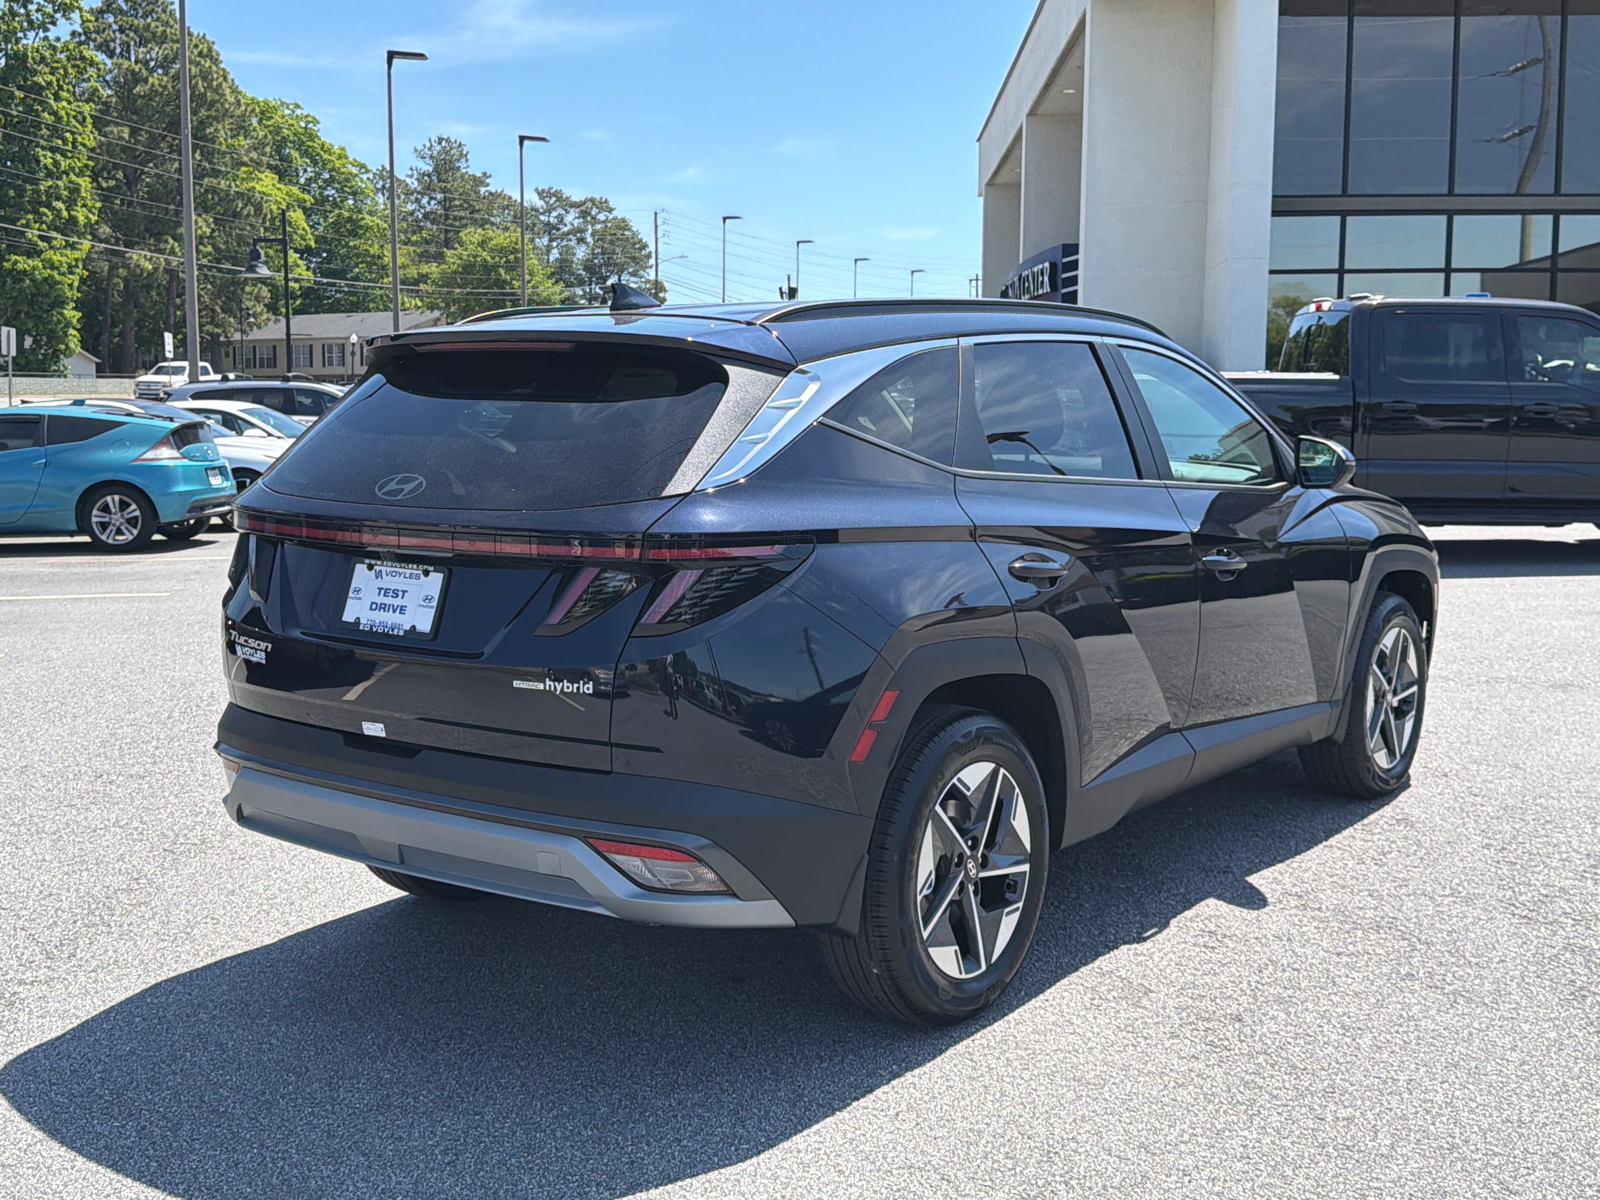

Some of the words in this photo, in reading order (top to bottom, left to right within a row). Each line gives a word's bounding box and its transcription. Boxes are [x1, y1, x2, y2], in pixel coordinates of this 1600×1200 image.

[1021, 261, 1051, 300] CENTER
[385, 570, 422, 581] VOYLES
[377, 587, 409, 600] TEST
[369, 602, 408, 616] DRIVE
[359, 623, 372, 632] ED
[372, 626, 405, 637] VOYLES
[242, 645, 266, 659] VOYLES
[546, 678, 594, 695] hybrid
